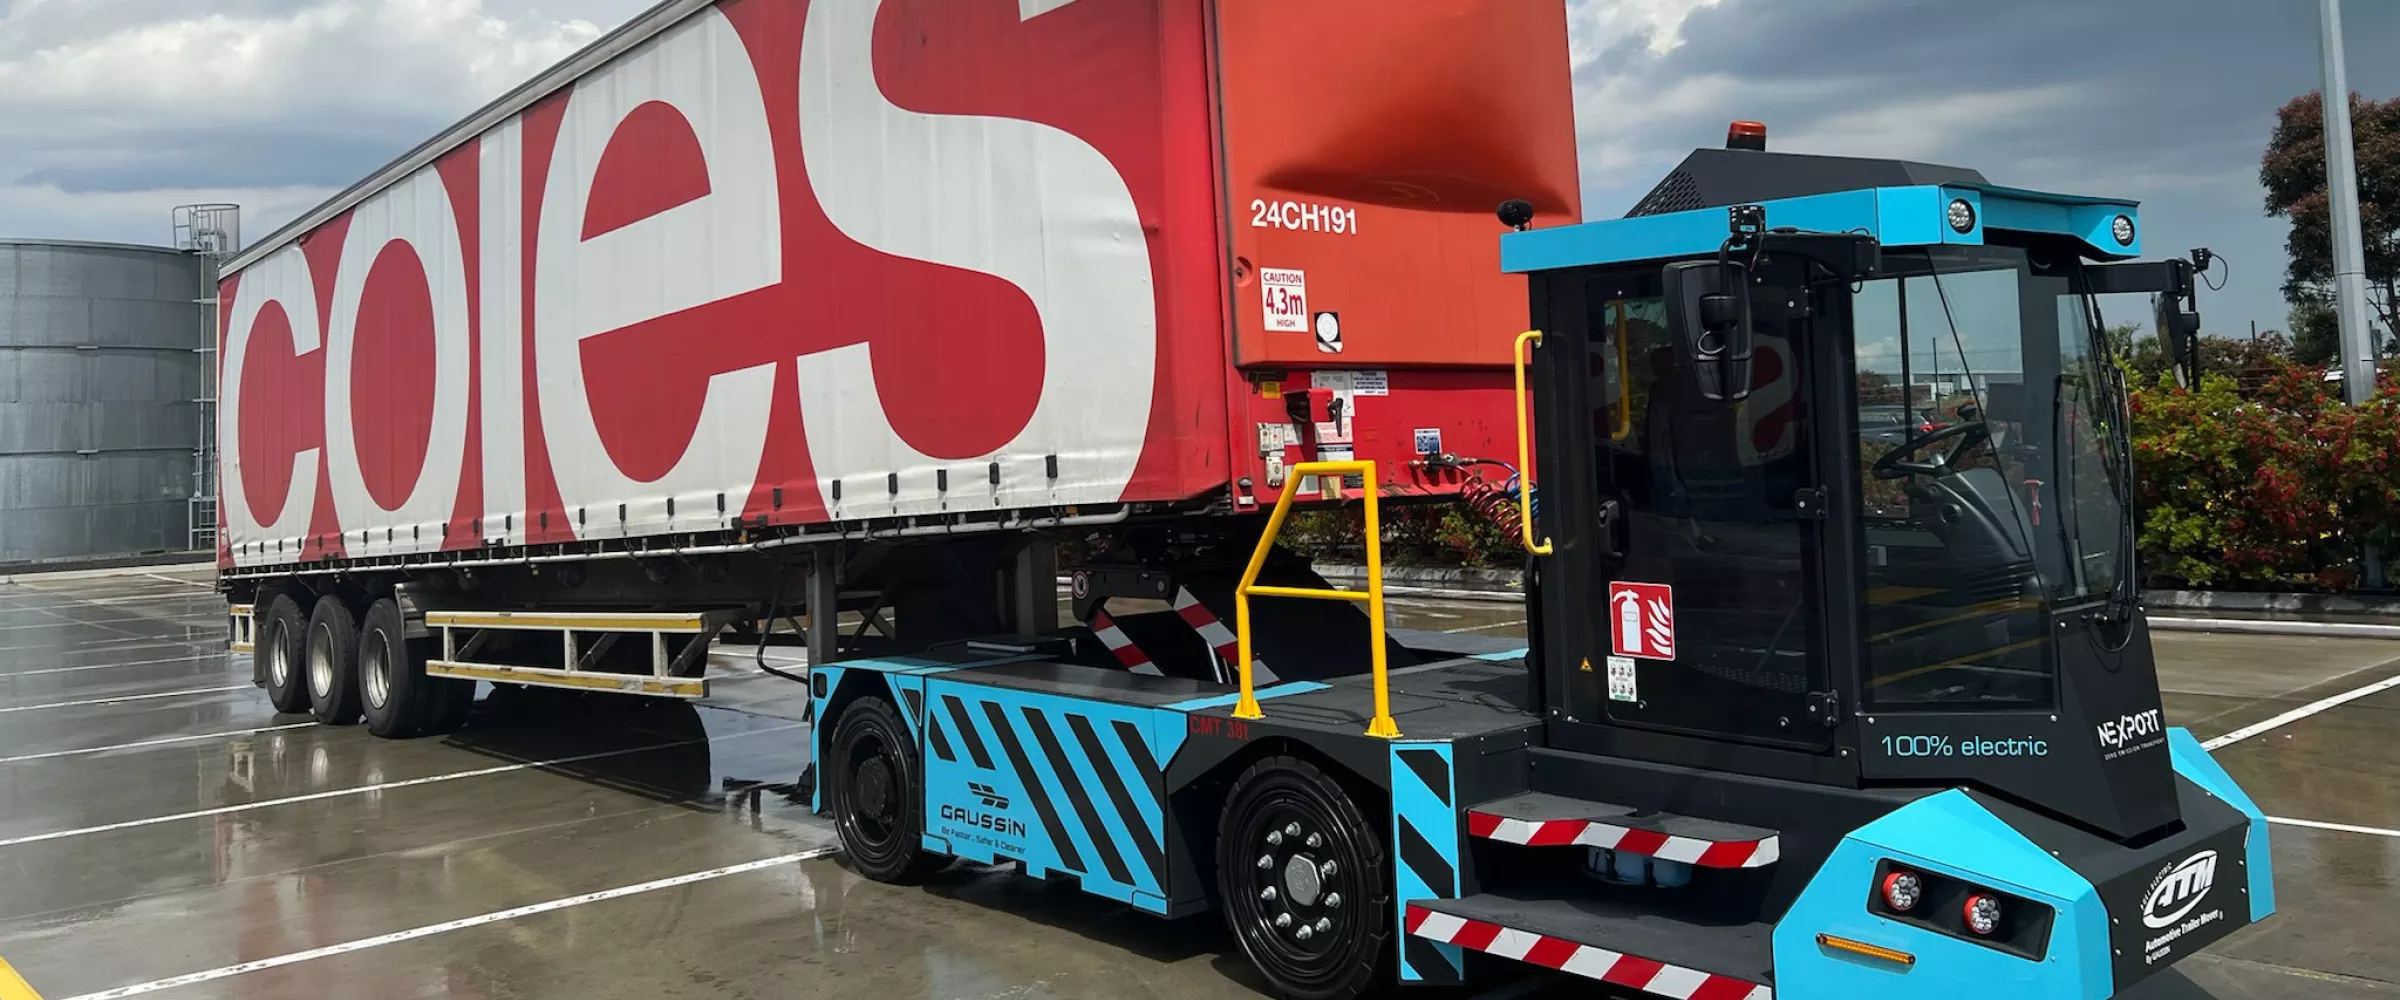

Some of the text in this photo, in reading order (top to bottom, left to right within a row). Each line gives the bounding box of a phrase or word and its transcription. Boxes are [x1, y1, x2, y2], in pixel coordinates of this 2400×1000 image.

[1250, 198, 1357, 235] 24CH191
[220, 0, 1157, 567] coles
[1263, 271, 1302, 284] CAUTION
[1266, 286, 1304, 316] 4.3m
[1276, 319, 1296, 328] HIGH
[1189, 713, 1249, 741] CMT 38t
[2096, 708, 2160, 749] NEXPORT
[1881, 735, 2048, 757] 100% electric
[2157, 855, 2218, 907] ATM
[2145, 909, 2219, 953] Automotive Trailer Mover
